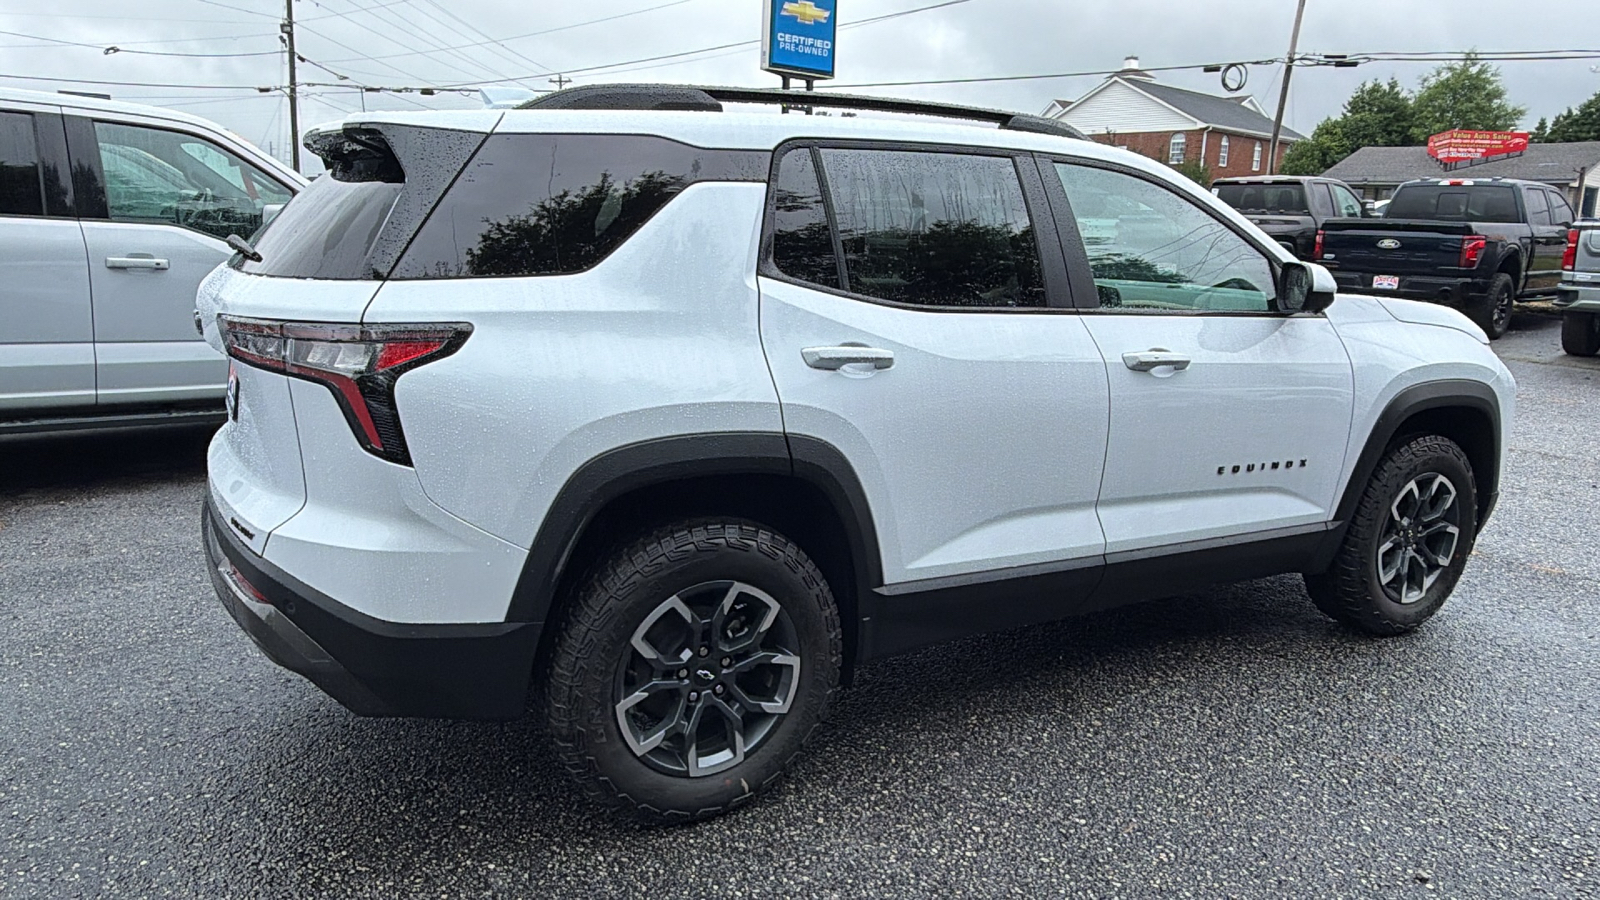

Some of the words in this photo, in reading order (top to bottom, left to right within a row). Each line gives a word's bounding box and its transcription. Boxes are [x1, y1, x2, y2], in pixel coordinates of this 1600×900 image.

[777, 32, 831, 49] CERTIFIED
[779, 42, 829, 57] PRE-OWNED
[1217, 459, 1307, 475] EQUINOX
